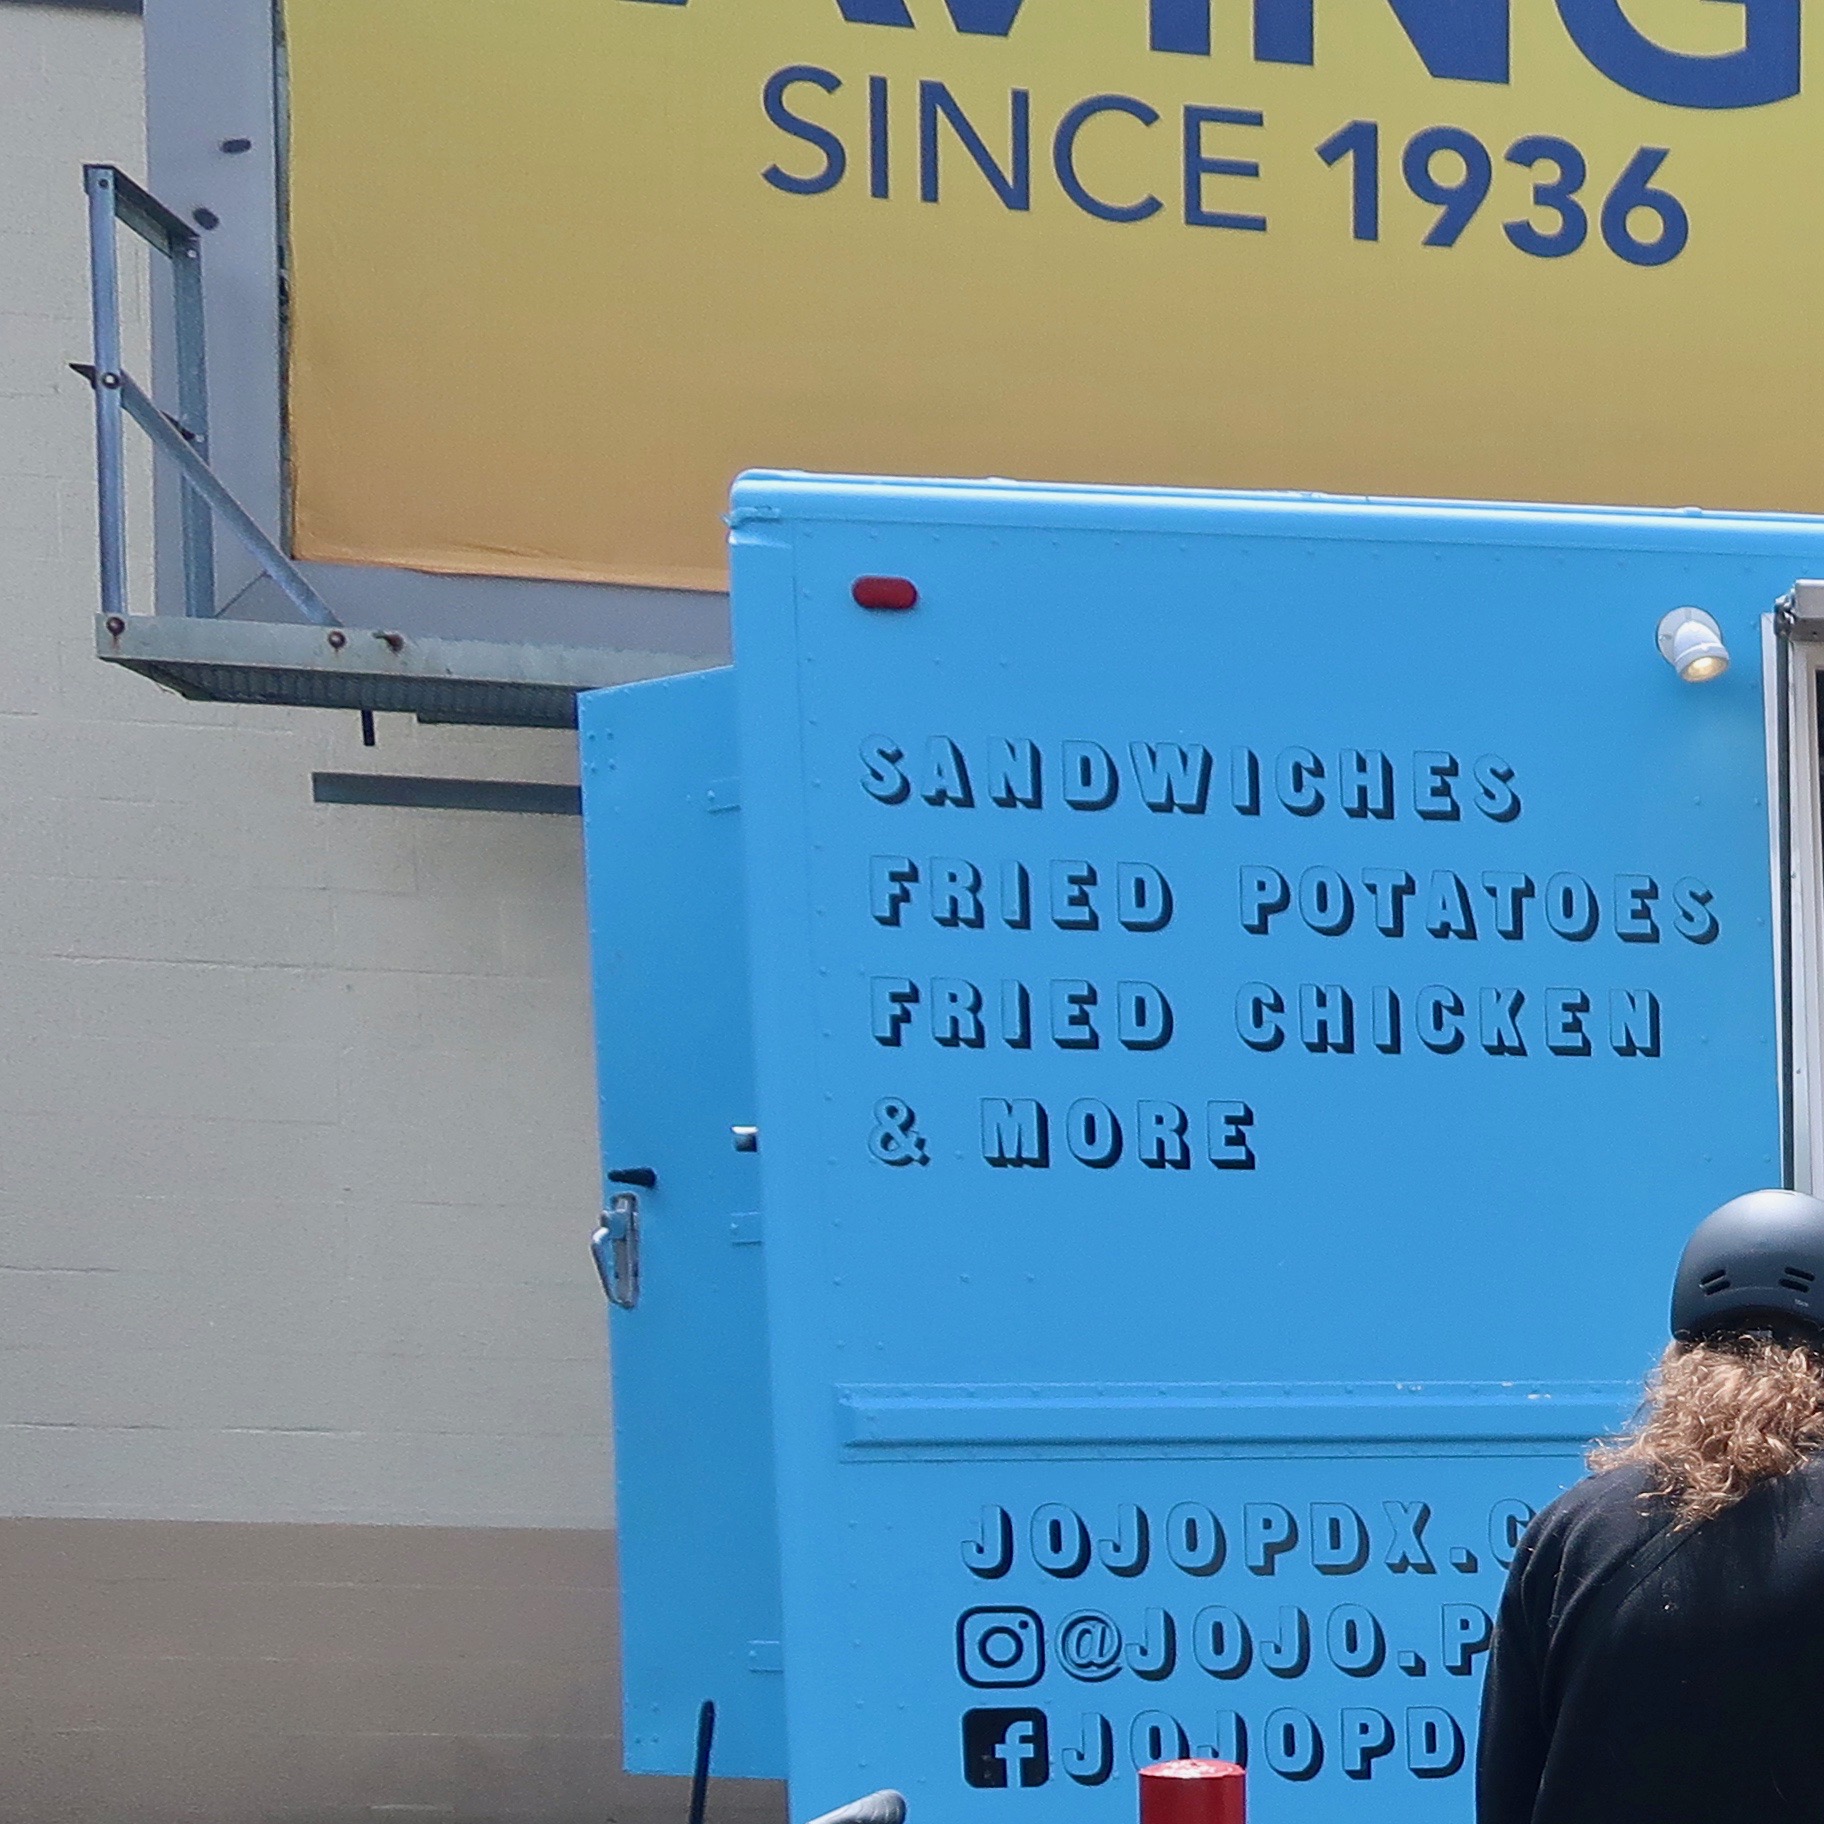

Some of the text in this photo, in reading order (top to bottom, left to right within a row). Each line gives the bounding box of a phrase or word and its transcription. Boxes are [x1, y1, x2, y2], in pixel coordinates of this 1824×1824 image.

[760, 65, 1268, 234] SINCE
[1314, 118, 1690, 267] 1936
[859, 733, 1523, 824] SANDWICHES
[868, 854, 1722, 945] FRIED POTATOES
[868, 976, 1662, 1058] FRIED CHICKEN
[867, 1095, 1256, 1169] & MORE
[960, 1498, 1535, 1579] JOJOPDX.C
[1054, 1602, 1495, 1683] @JOJO.P
[1061, 1705, 1465, 1786] JOJOPD
